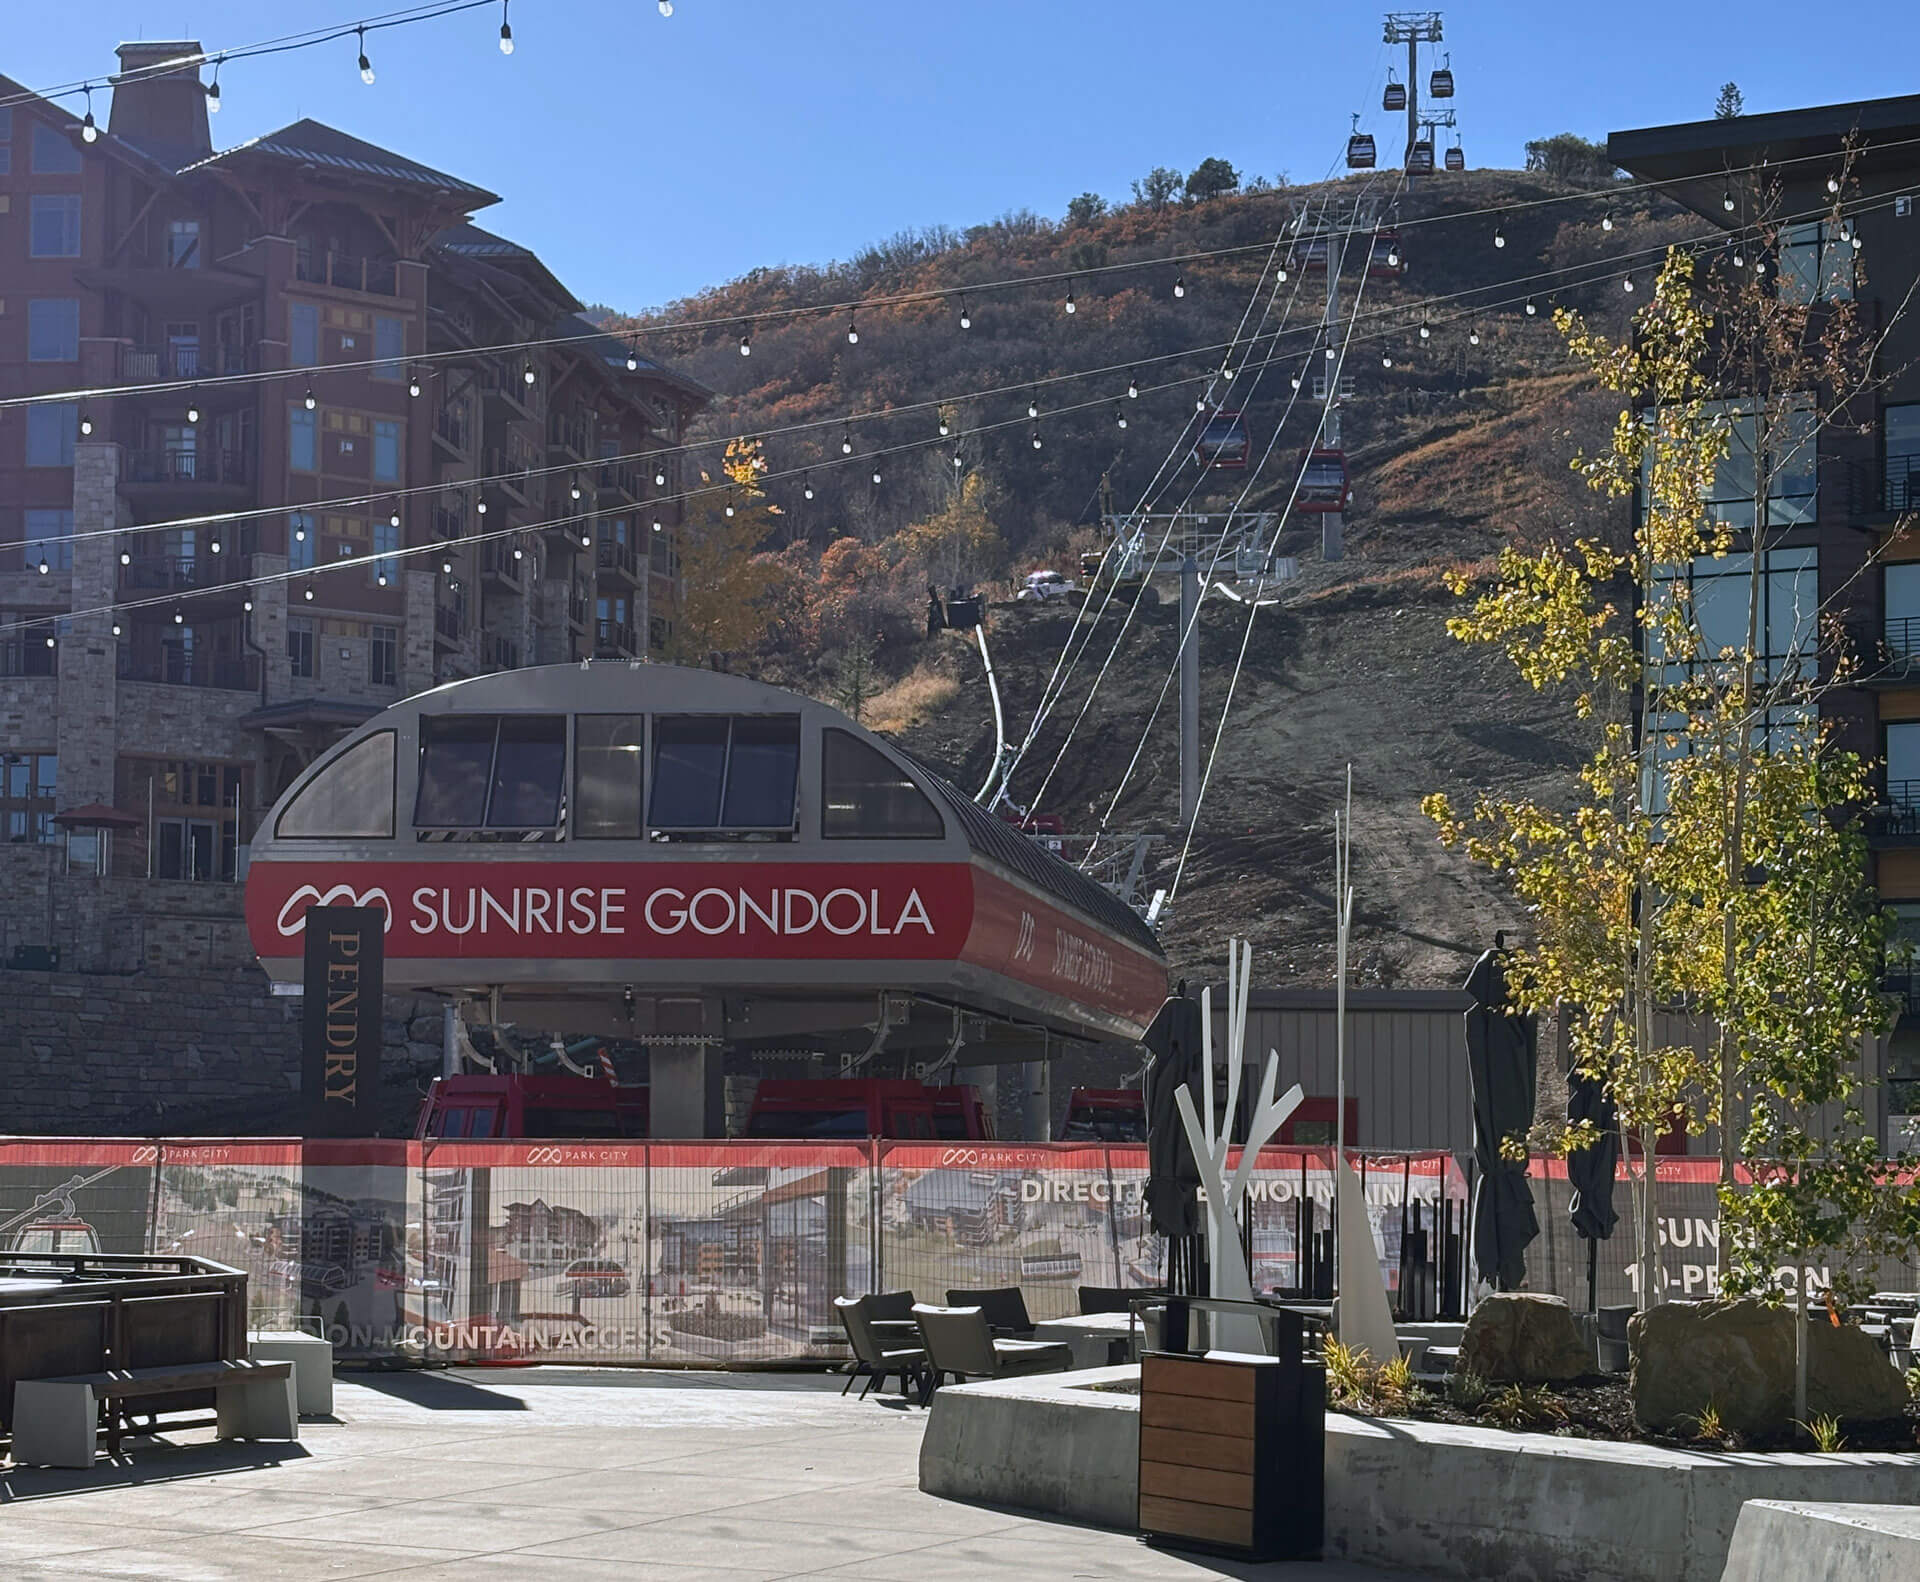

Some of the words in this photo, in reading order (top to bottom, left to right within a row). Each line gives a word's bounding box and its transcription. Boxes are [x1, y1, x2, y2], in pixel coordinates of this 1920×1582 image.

[410, 887, 626, 936] SUNRISE
[644, 887, 936, 937] GONDOLA
[324, 928, 360, 1108] PENDRY
[169, 1149, 198, 1159] PARK
[202, 1149, 230, 1159] CITY
[565, 1151, 596, 1160] PARK
[600, 1151, 629, 1160] CITY
[981, 1153, 1012, 1163] PARK
[1016, 1153, 1046, 1163] CITY
[1655, 1165, 1681, 1176] CITY
[1021, 1179, 1128, 1202] DIRECT
[383, 1324, 552, 1351] MOUNTAIN
[557, 1325, 674, 1351] ACCESS
